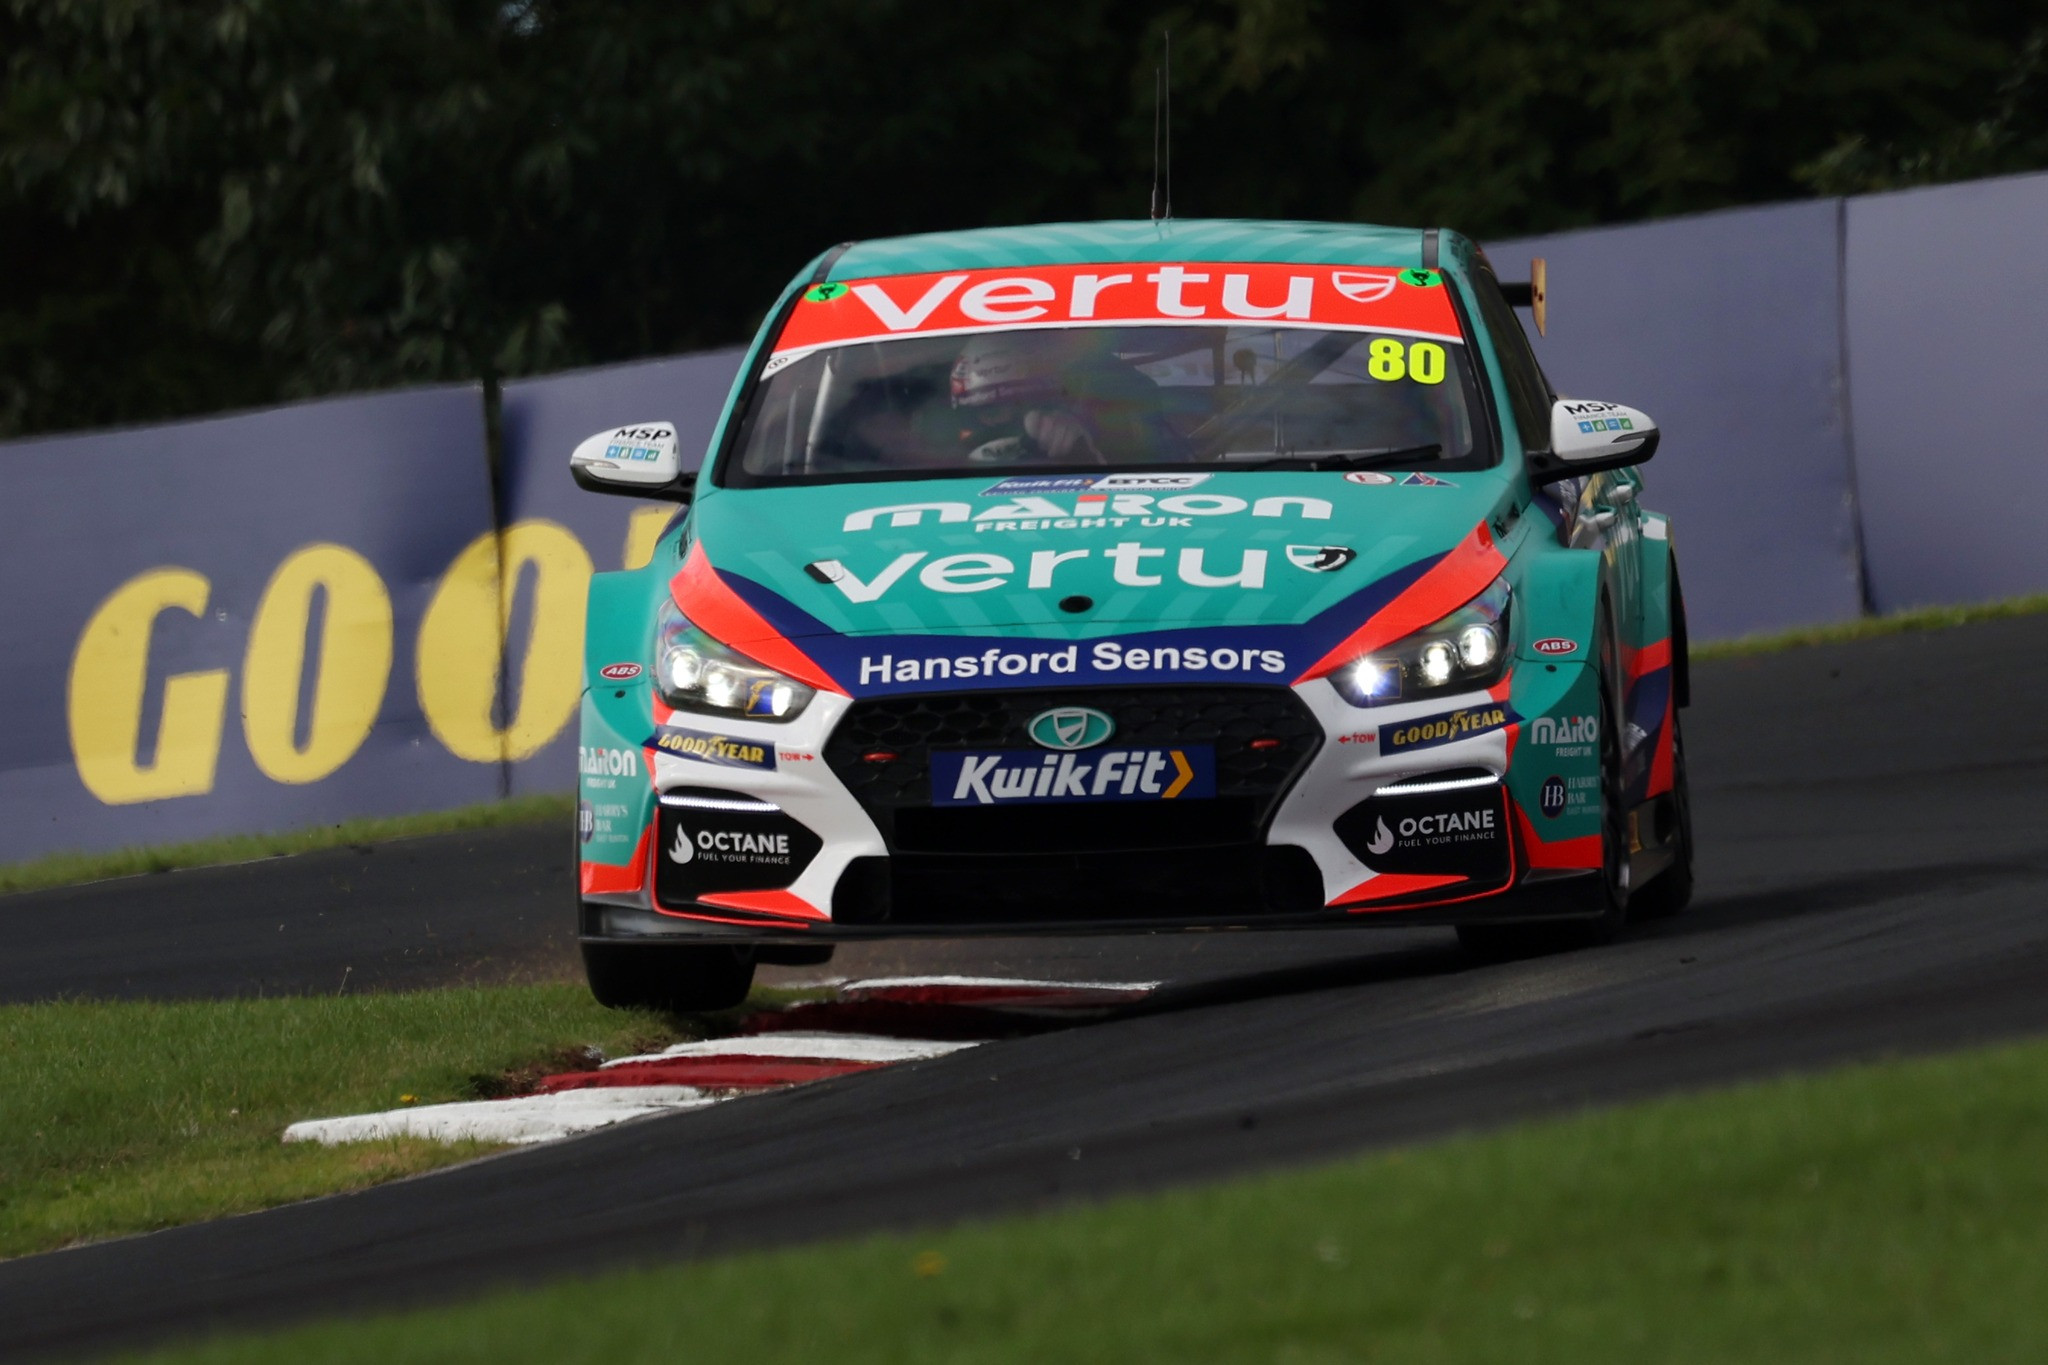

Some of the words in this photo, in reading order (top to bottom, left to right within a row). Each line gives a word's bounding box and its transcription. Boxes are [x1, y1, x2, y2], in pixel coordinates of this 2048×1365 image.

[1368, 338, 1447, 385] 80
[1563, 403, 1618, 415] MSP
[614, 428, 671, 440] MSP
[975, 517, 1131, 533] FREIGHT
[1139, 516, 1193, 527] UK
[1541, 641, 1571, 651] ABS
[67, 505, 678, 806] GOO
[860, 645, 1078, 684] Hansford
[1092, 642, 1287, 673] Sensors
[606, 666, 639, 675] ABS
[1353, 733, 1377, 743] TOW
[778, 751, 801, 761] TOW
[1544, 785, 1564, 807] HB
[1400, 809, 1495, 836] OCTANE
[697, 830, 790, 854] OCTANE
[1399, 836, 1420, 848] FUEL
[1425, 834, 1452, 845] YOUR
[1455, 832, 1495, 842] FINANCE
[698, 852, 719, 861] FUEL
[722, 854, 748, 863] YOUR
[750, 856, 791, 865] FINANCE
